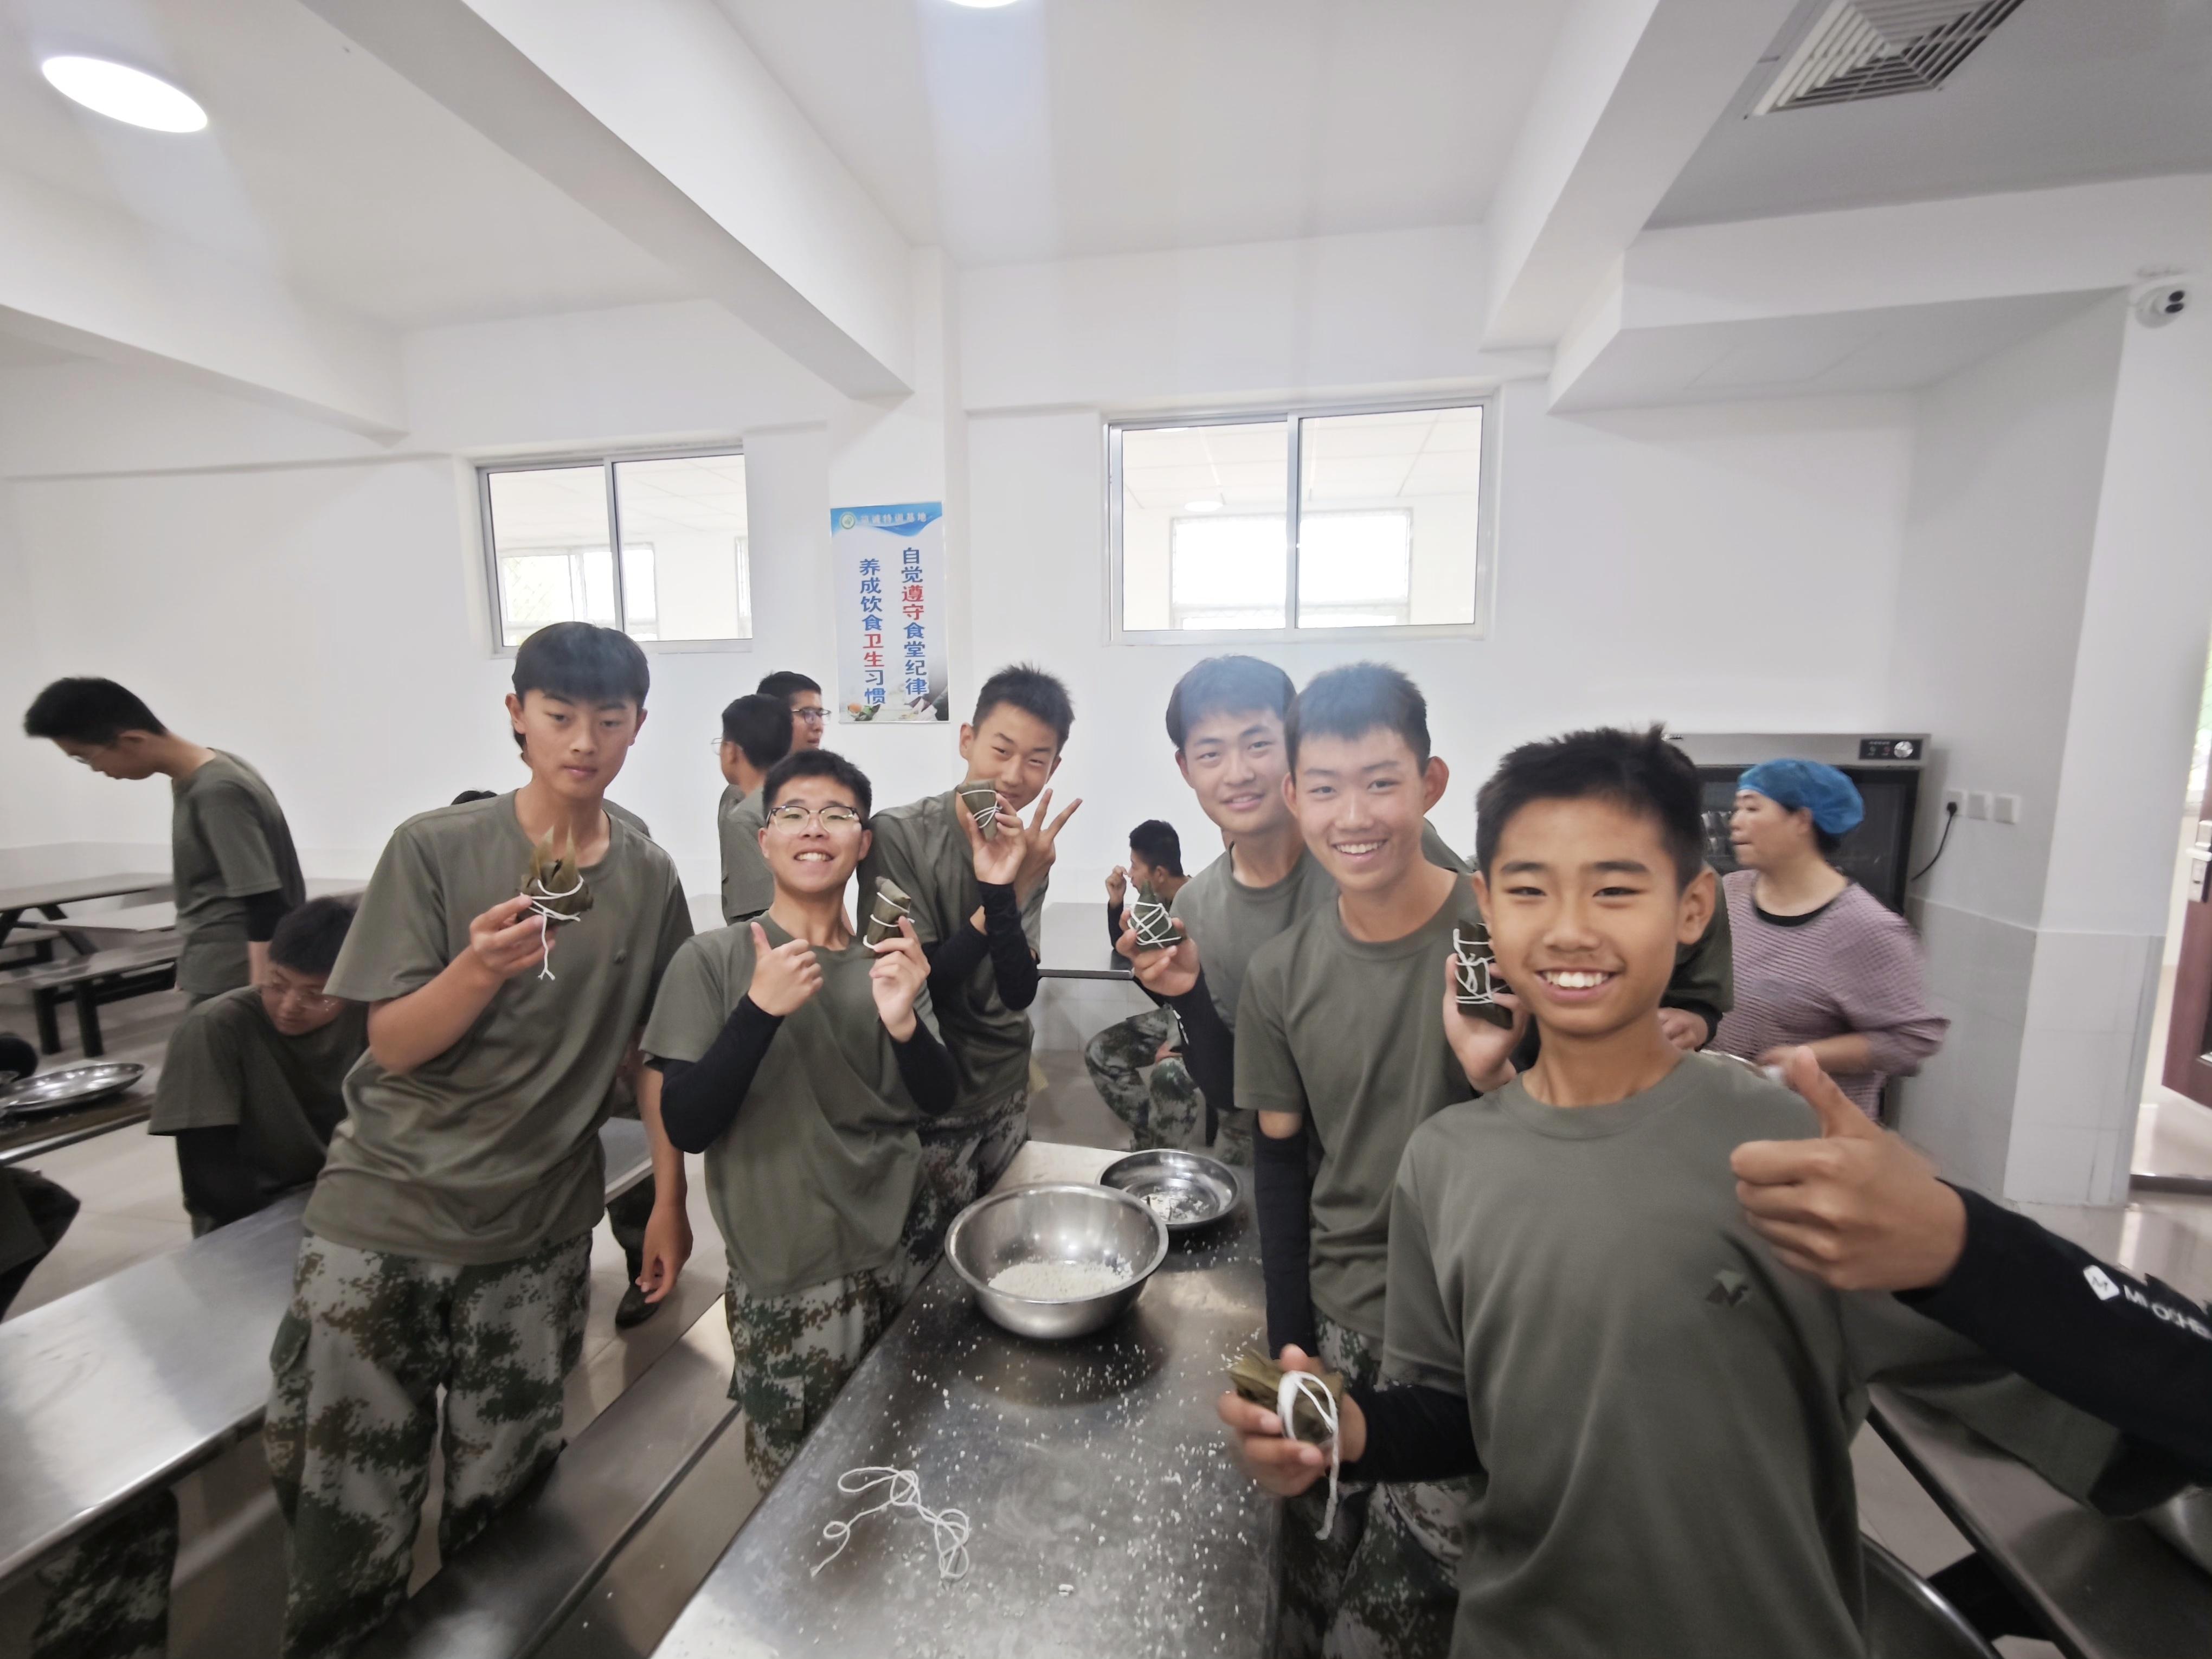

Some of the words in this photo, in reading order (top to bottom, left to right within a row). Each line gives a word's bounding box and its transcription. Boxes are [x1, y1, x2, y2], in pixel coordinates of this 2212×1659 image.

[859, 558, 886, 705] 养成饮食卫生习惯
[901, 547, 929, 695] 自觉遵守食堂纪律
